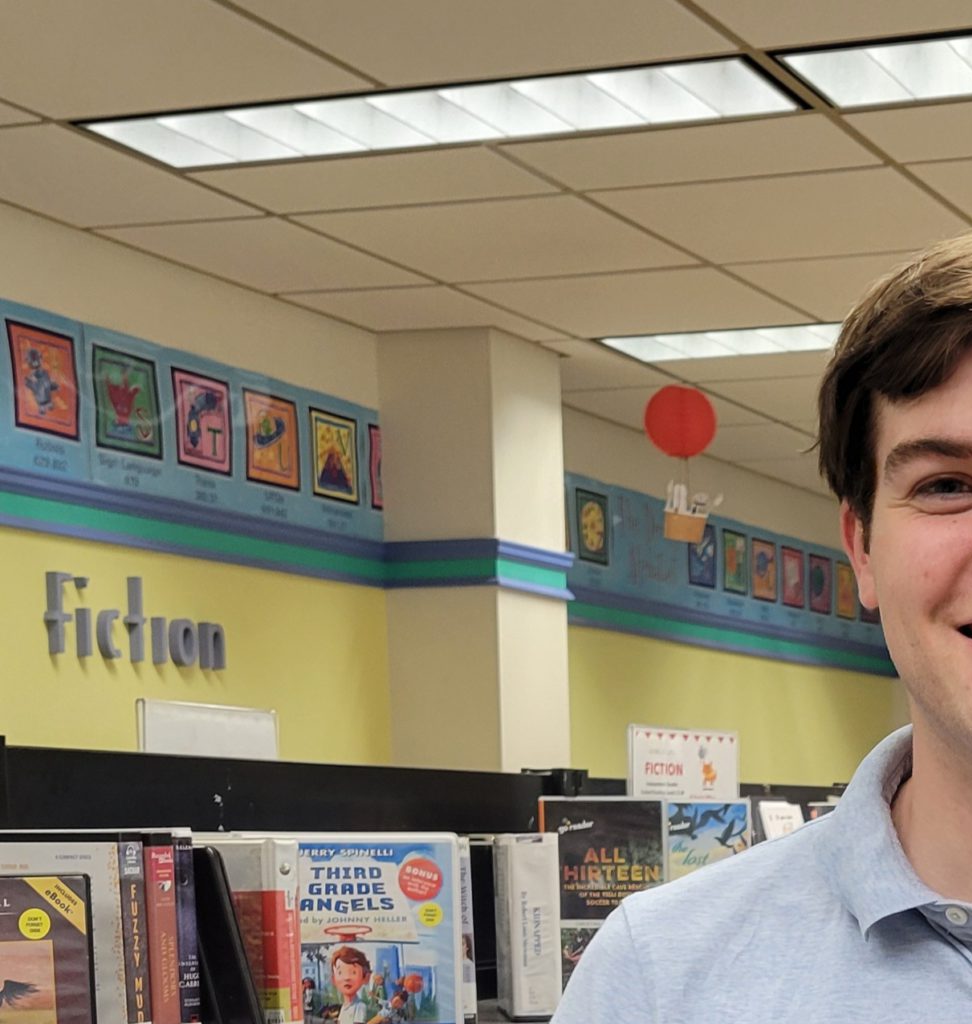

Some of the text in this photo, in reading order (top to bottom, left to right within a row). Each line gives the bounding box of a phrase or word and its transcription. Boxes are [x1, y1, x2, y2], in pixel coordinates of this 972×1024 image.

[644, 761, 684, 777] FICTION
[339, 848, 394, 857] SPINELLI
[583, 847, 626, 864] ALL
[682, 849, 709, 865] lost
[310, 866, 382, 880] THIRD
[405, 865, 439, 881] BONUS
[563, 865, 660, 882] HIRTEEN
[308, 882, 386, 895] GRADE
[45, 888, 72, 915] eBook
[300, 897, 395, 915] ANGELS
[460, 886, 468, 910] Witch
[312, 917, 323, 925] by
[326, 916, 370, 924] JOHNNY
[533, 907, 541, 956] KIDNAPPED
[183, 973, 200, 981] HUG
